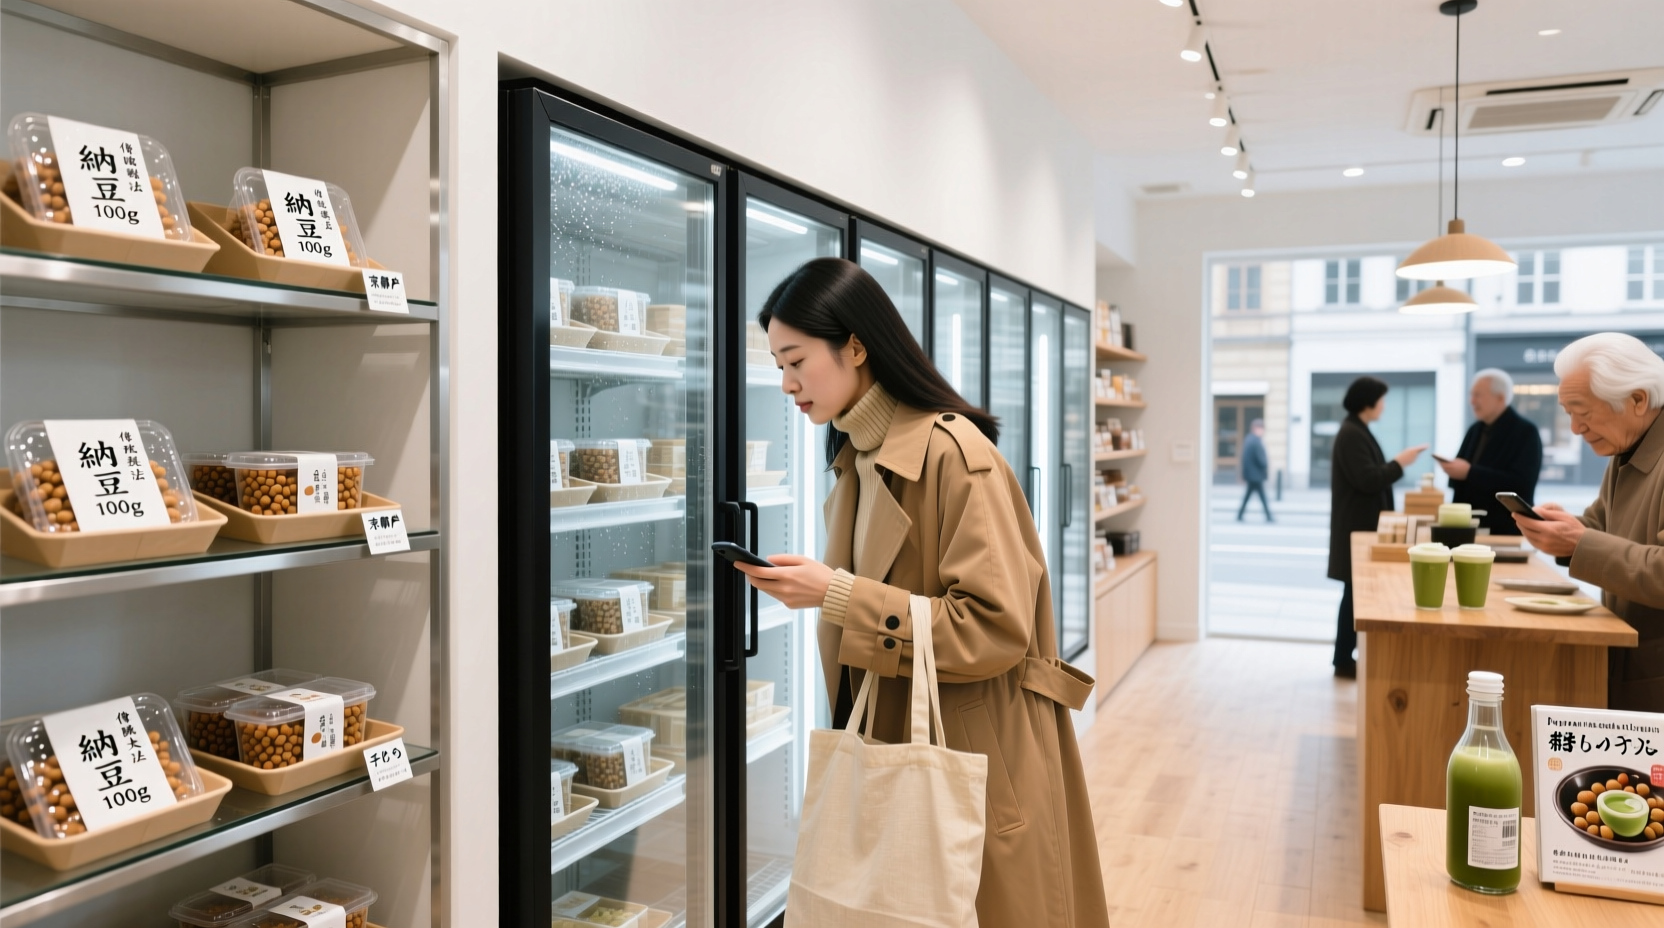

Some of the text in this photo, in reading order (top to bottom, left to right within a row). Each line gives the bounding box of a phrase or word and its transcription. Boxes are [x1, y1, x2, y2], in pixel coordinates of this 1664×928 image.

[78, 144, 126, 203] 納豆
[93, 204, 140, 225] 100g
[284, 191, 322, 239] 納豆
[298, 240, 333, 258] 100g
[78, 440, 129, 497] 納豆
[95, 499, 145, 518] 100g
[78, 729, 133, 791] 納豆
[102, 786, 151, 809] 100g
